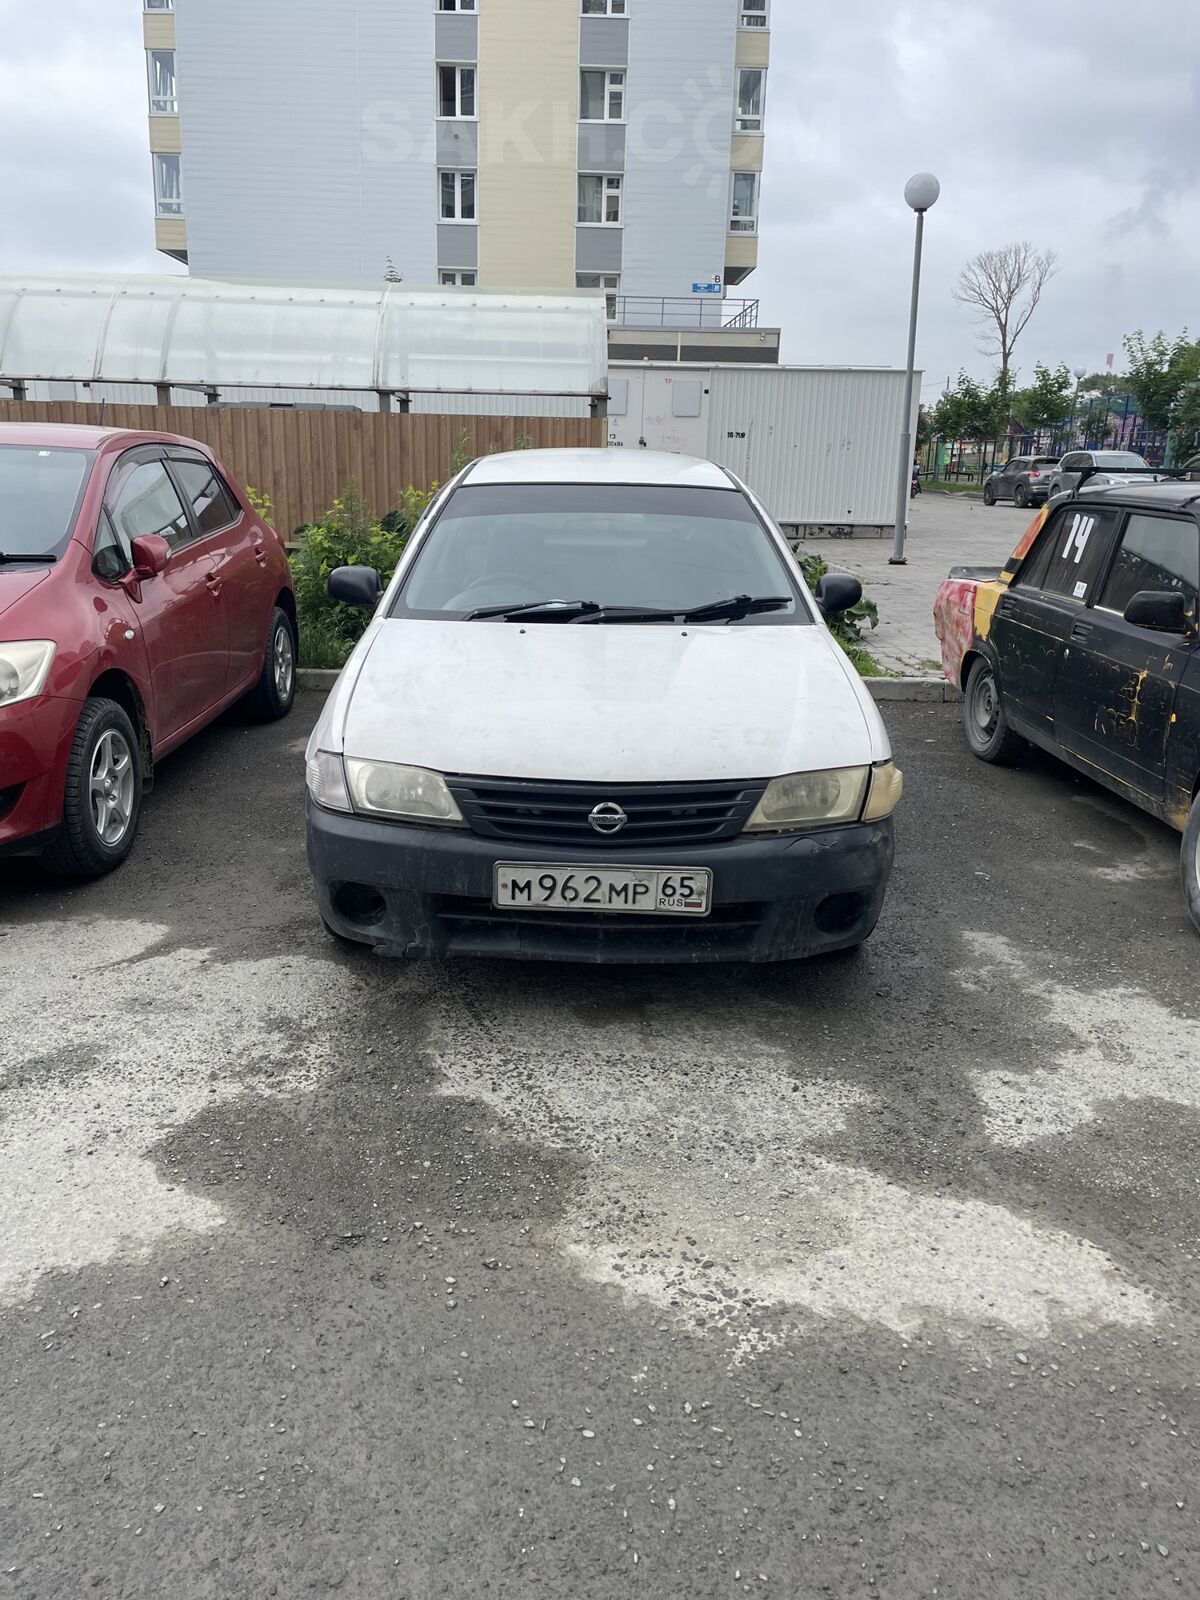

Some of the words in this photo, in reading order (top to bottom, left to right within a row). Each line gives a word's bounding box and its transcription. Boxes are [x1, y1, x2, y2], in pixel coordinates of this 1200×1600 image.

[1062, 513, 1095, 564] 14
[661, 876, 695, 898] 65
[659, 897, 684, 907] RUS
